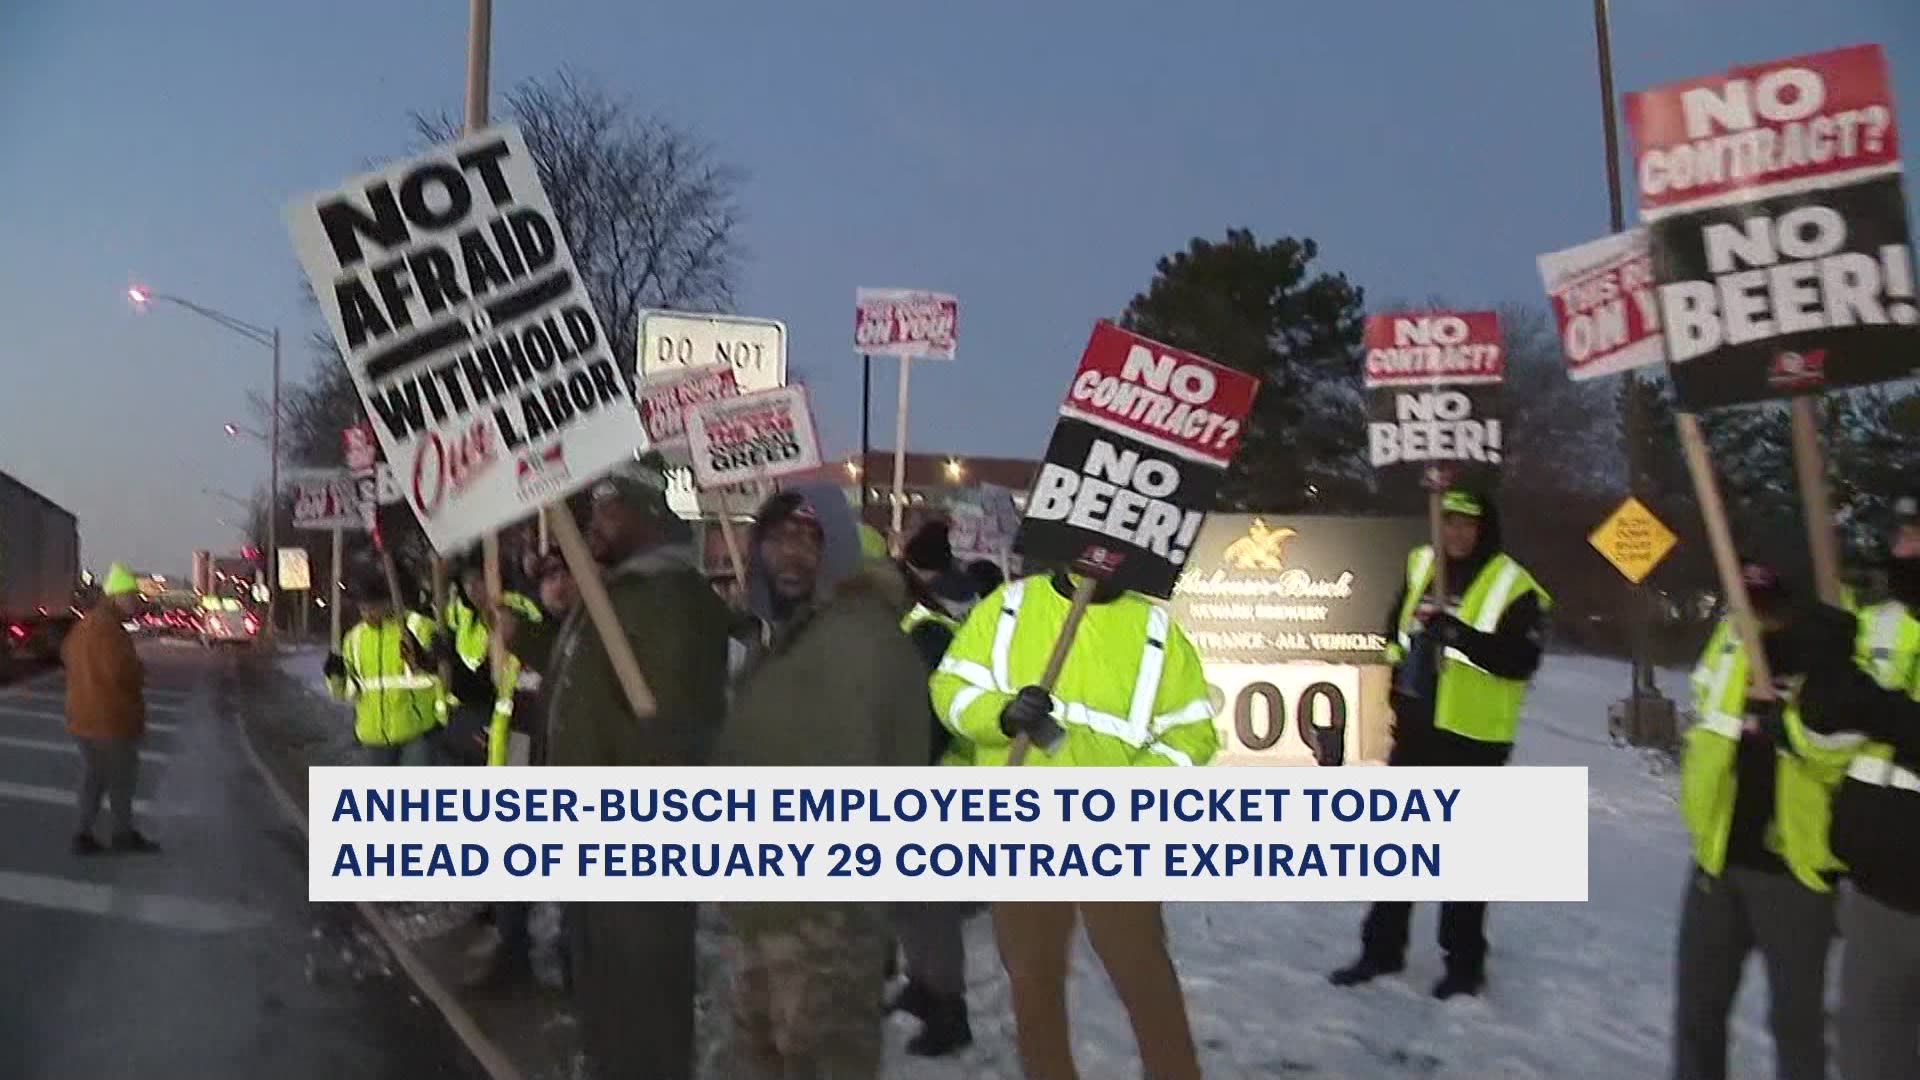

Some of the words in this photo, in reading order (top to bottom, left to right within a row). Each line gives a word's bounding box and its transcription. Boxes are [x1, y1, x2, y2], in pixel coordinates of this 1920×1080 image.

[1680, 67, 1825, 139] NO
[1640, 104, 1890, 196] CONTRACT?
[317, 138, 514, 268] NOT
[1702, 205, 1848, 274] NO
[333, 208, 556, 349] AFRAID
[1659, 244, 1919, 363] BEER!
[658, 336, 693, 365] DO
[715, 341, 765, 371] NOT
[1366, 344, 1500, 373] CONTRACT?
[1394, 317, 1470, 347] NO
[364, 304, 598, 441] WITHHOLD
[491, 358, 624, 452] LABOR
[1120, 345, 1216, 404] NO
[1395, 391, 1472, 421] NO
[1072, 369, 1239, 448] CONTRACT?
[1368, 419, 1503, 467] BEER!
[711, 442, 800, 472] GREED
[1082, 438, 1180, 498] NO
[1026, 462, 1204, 566] BEER!
